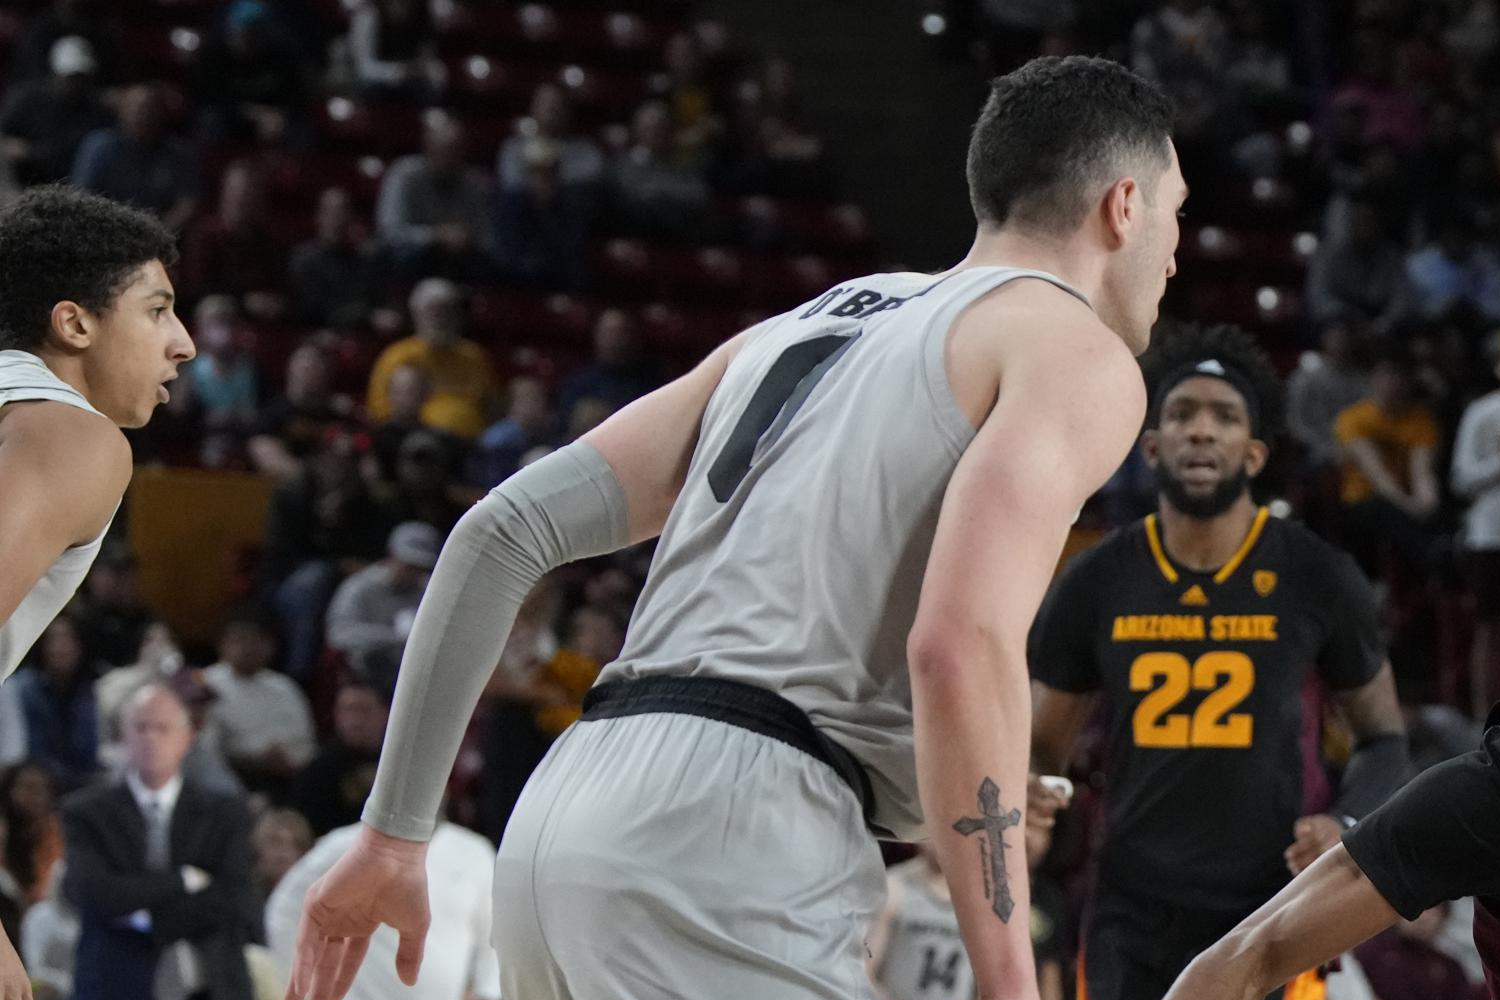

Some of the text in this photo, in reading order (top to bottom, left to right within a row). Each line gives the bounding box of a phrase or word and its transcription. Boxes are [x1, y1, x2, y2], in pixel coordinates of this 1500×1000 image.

[1111, 614, 1279, 641] ARIZONA STATE
[1128, 650, 1256, 748] 22
[917, 946, 962, 991] 14
